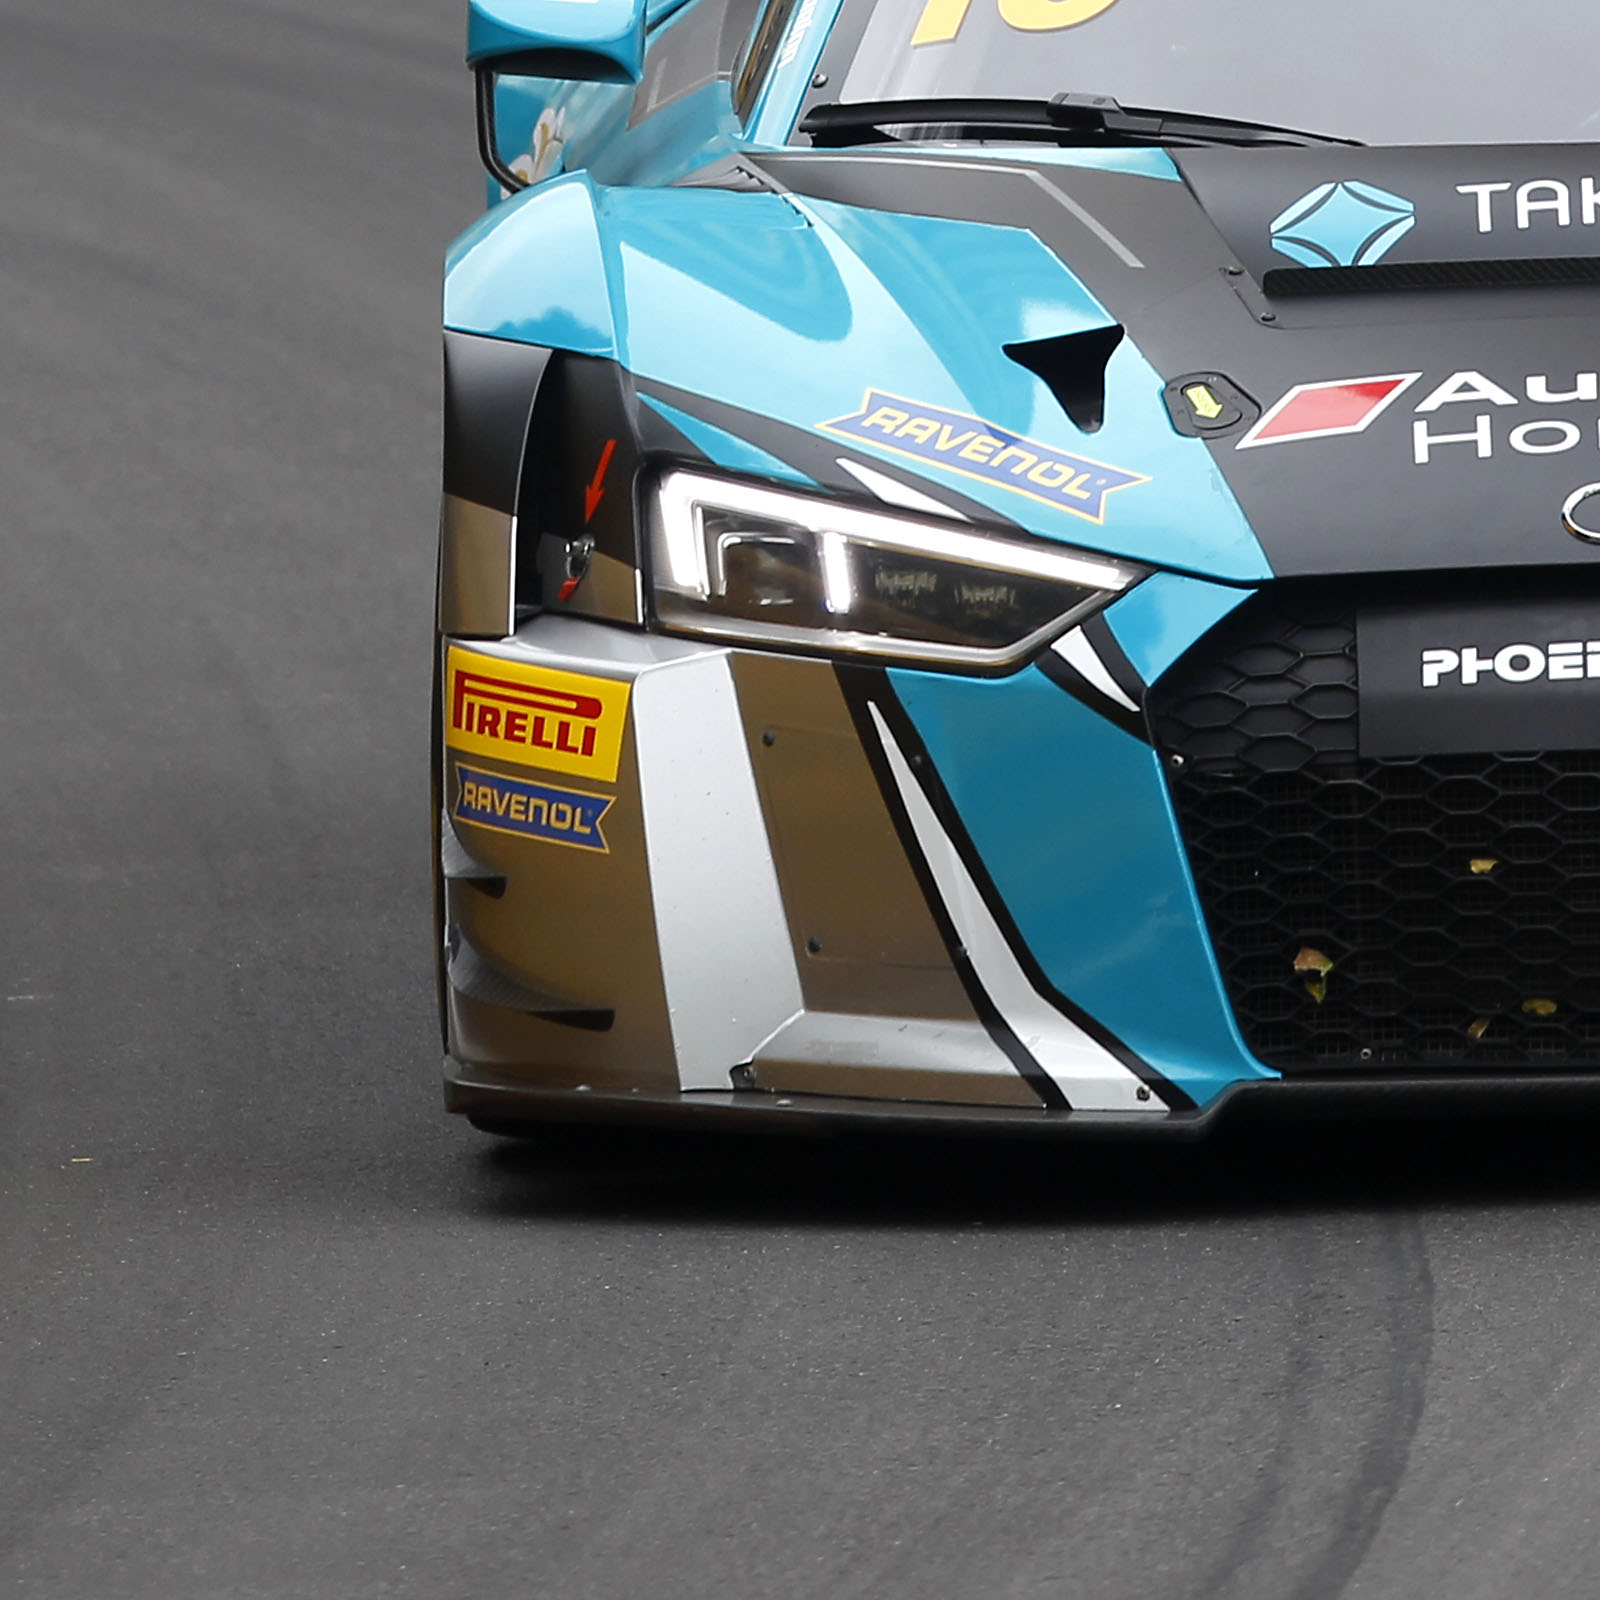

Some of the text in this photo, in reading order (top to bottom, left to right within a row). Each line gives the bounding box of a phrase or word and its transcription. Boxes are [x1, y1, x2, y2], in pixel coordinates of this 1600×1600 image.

[860, 405, 1096, 501] RAVENOL
[452, 668, 603, 758] PIRELLI
[463, 780, 592, 835] RAVENOL
